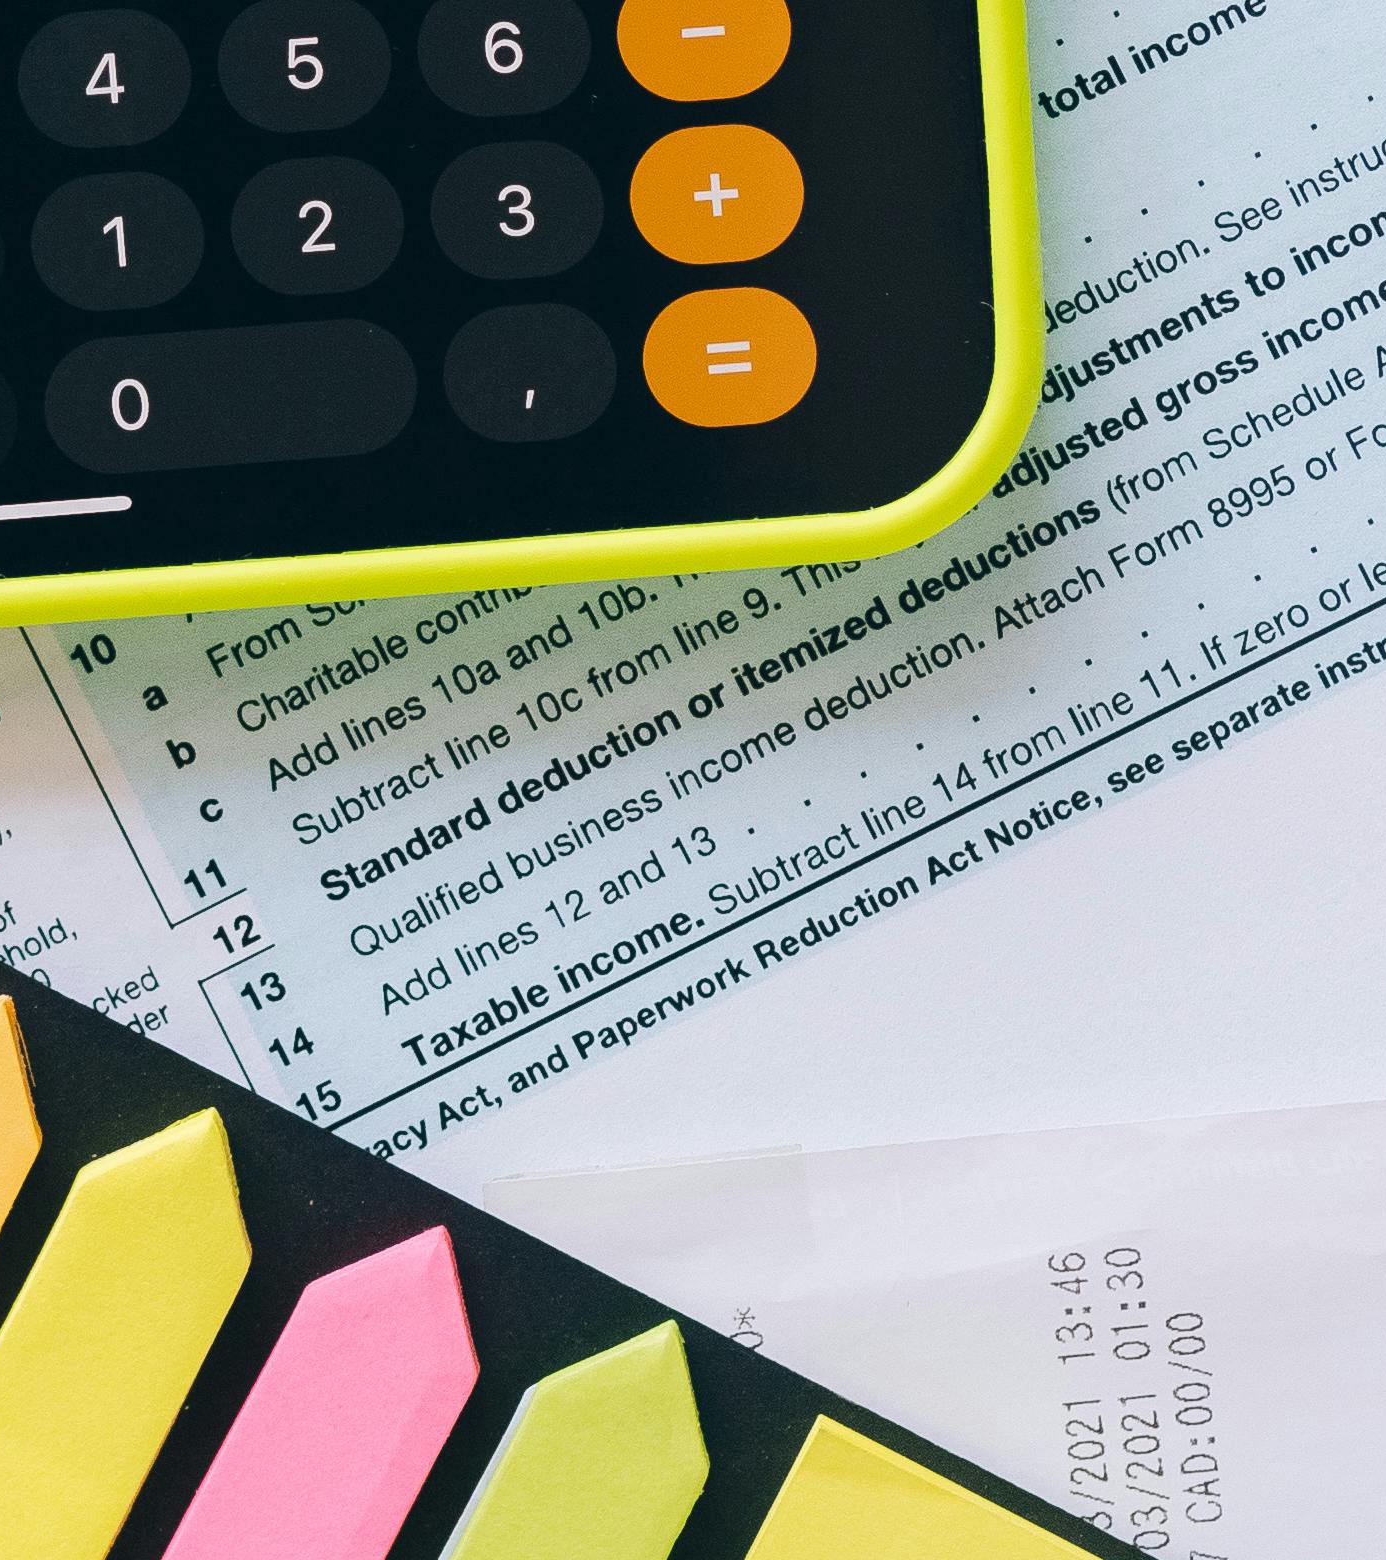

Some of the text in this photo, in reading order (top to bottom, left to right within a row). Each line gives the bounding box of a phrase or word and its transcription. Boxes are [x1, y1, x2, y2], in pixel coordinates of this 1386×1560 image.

[83, 50, 126, 106] 4
[286, 35, 326, 92] 5
[483, 19, 525, 76] 6
[1036, 53, 1129, 120] total
[319, 795, 493, 902] Standard
[496, 708, 683, 816] deduction
[686, 681, 726, 720] or
[729, 594, 894, 698] itemized
[897, 498, 1102, 615] deductions
[1105, 449, 1200, 517] (from
[1201, 366, 1367, 461] Schedule
[1046, 1250, 1097, 1366] 13:46
[1102, 1245, 1153, 1363] 01:30
[1164, 1311, 1224, 1525] CAD:00/00
